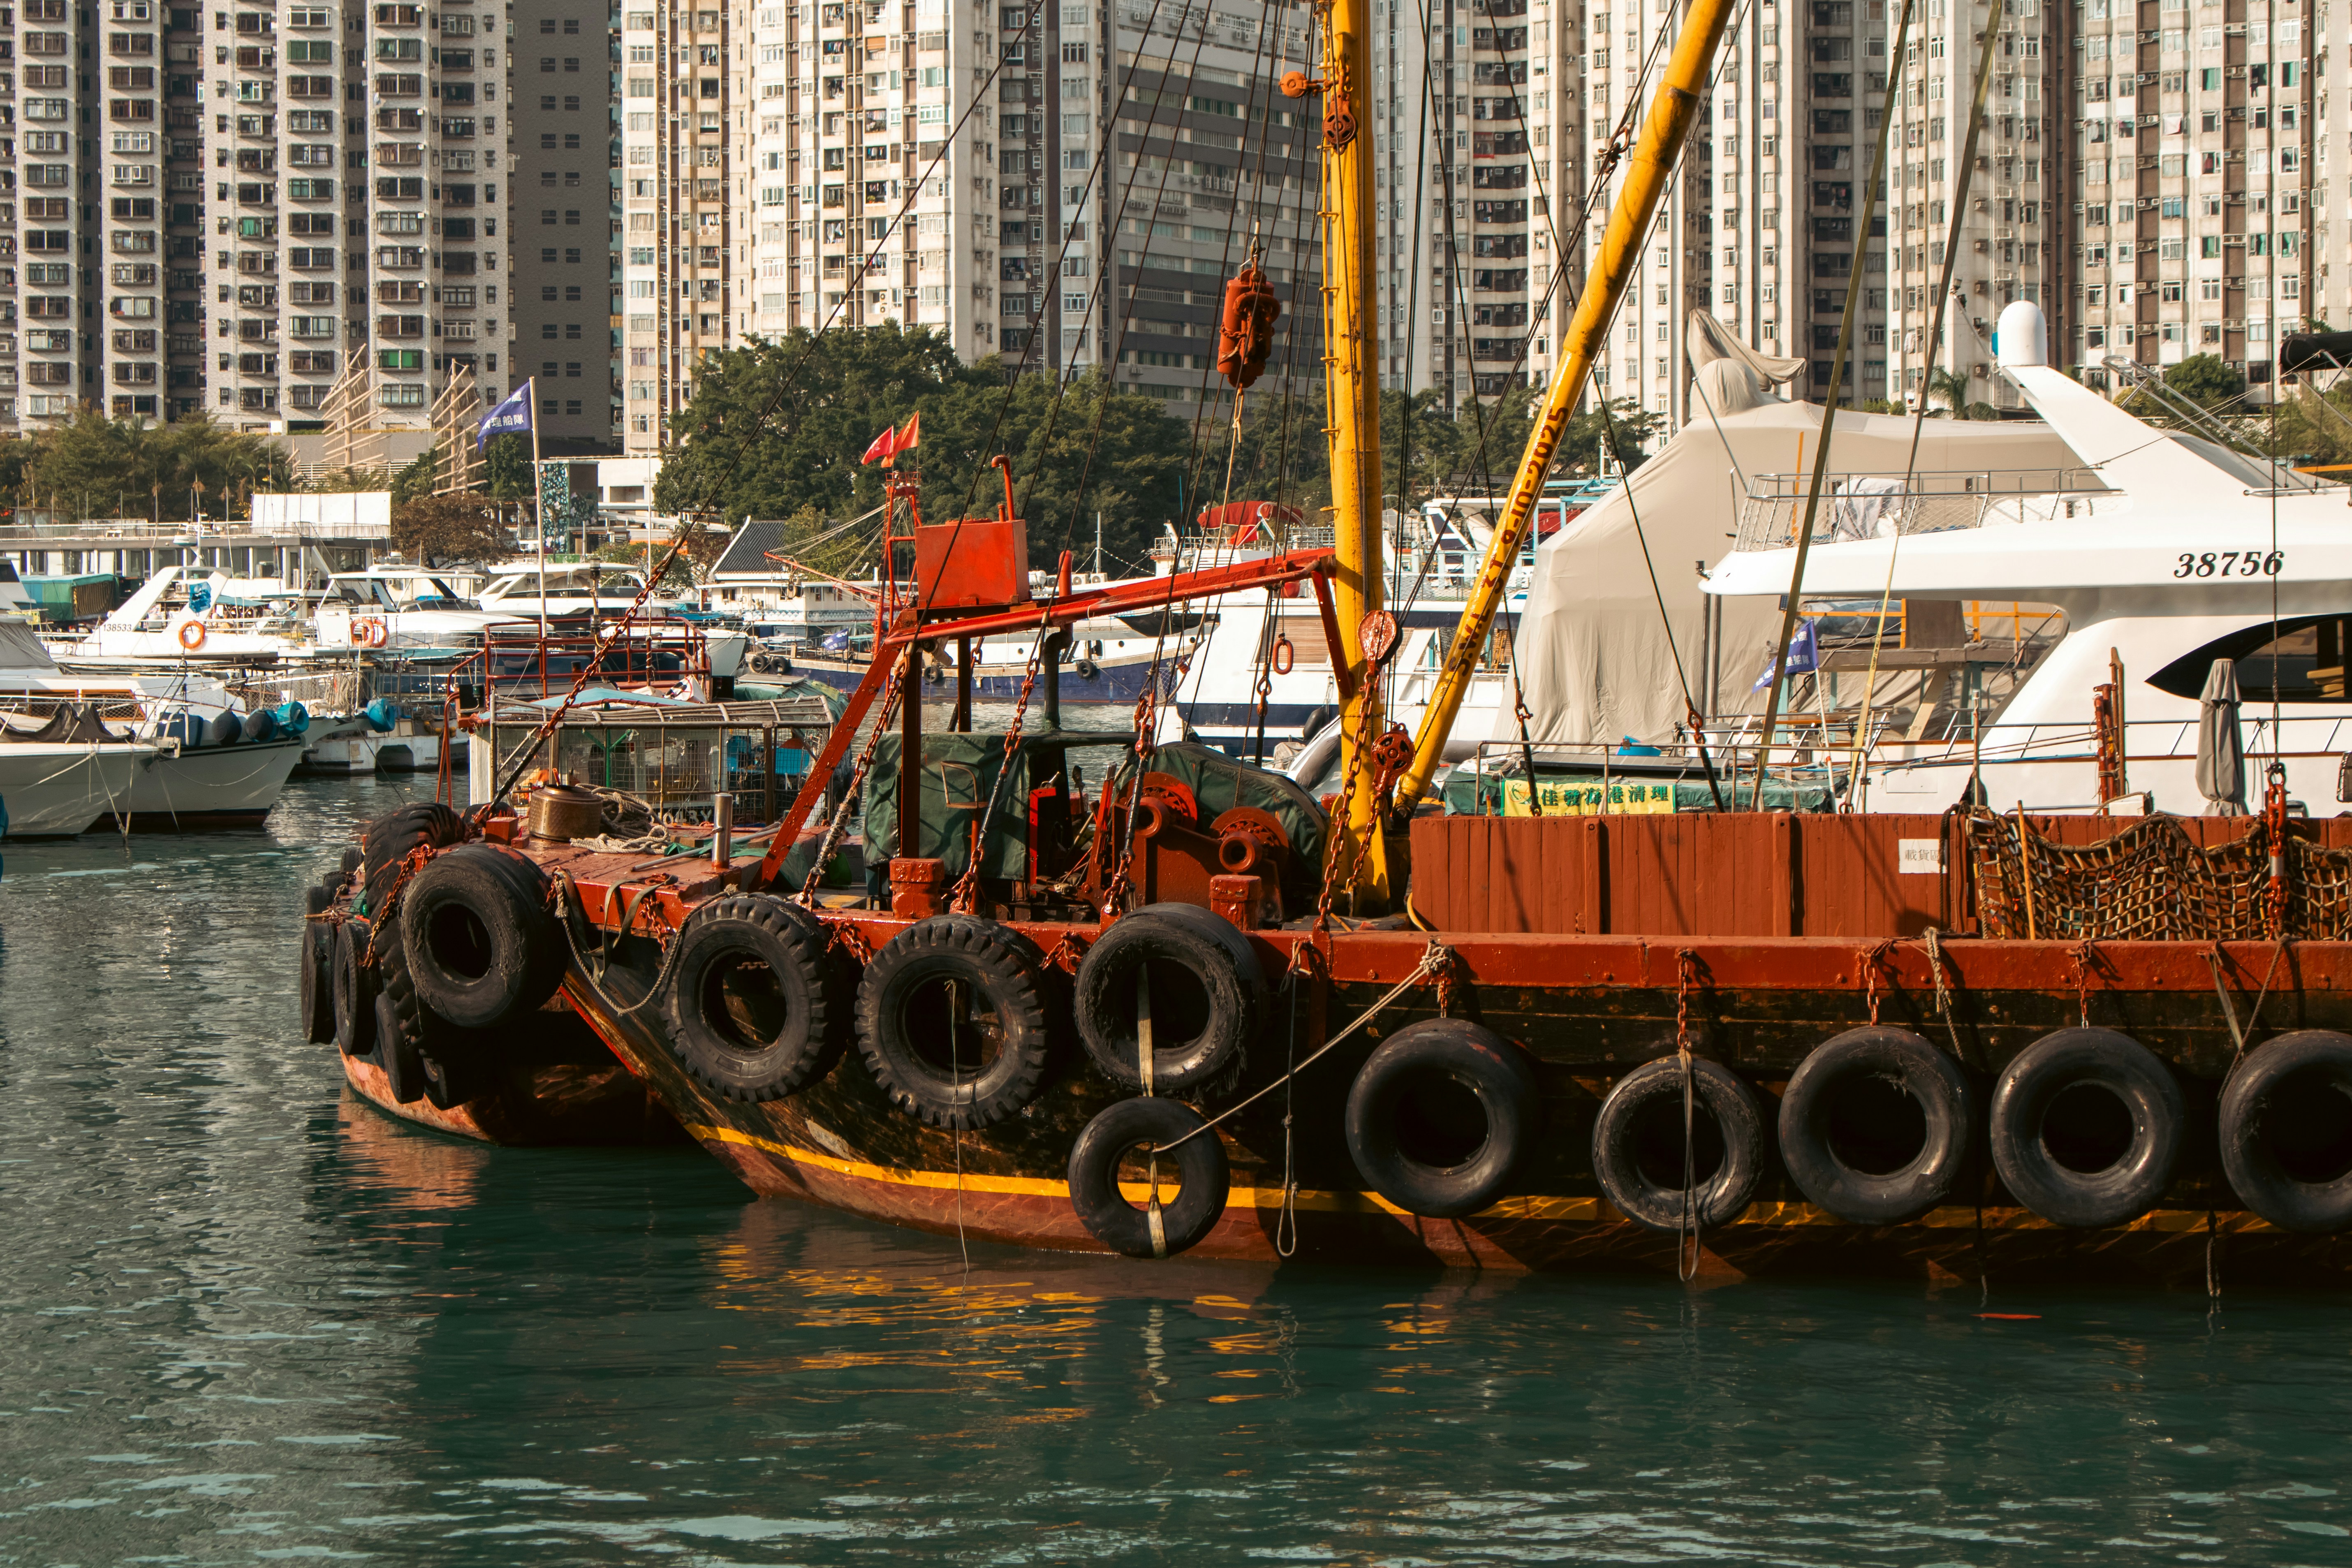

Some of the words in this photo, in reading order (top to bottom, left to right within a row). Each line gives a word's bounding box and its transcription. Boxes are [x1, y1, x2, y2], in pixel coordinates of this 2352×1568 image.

[1480, 553, 1510, 595] 3T
[1500, 406, 1569, 548] 9-10-2025
[2174, 551, 2285, 578] 38756
[104, 623, 132, 632] 138533
[1541, 785, 1669, 807] 佳發海港清理
[1904, 849, 1939, 862] 載貨區
